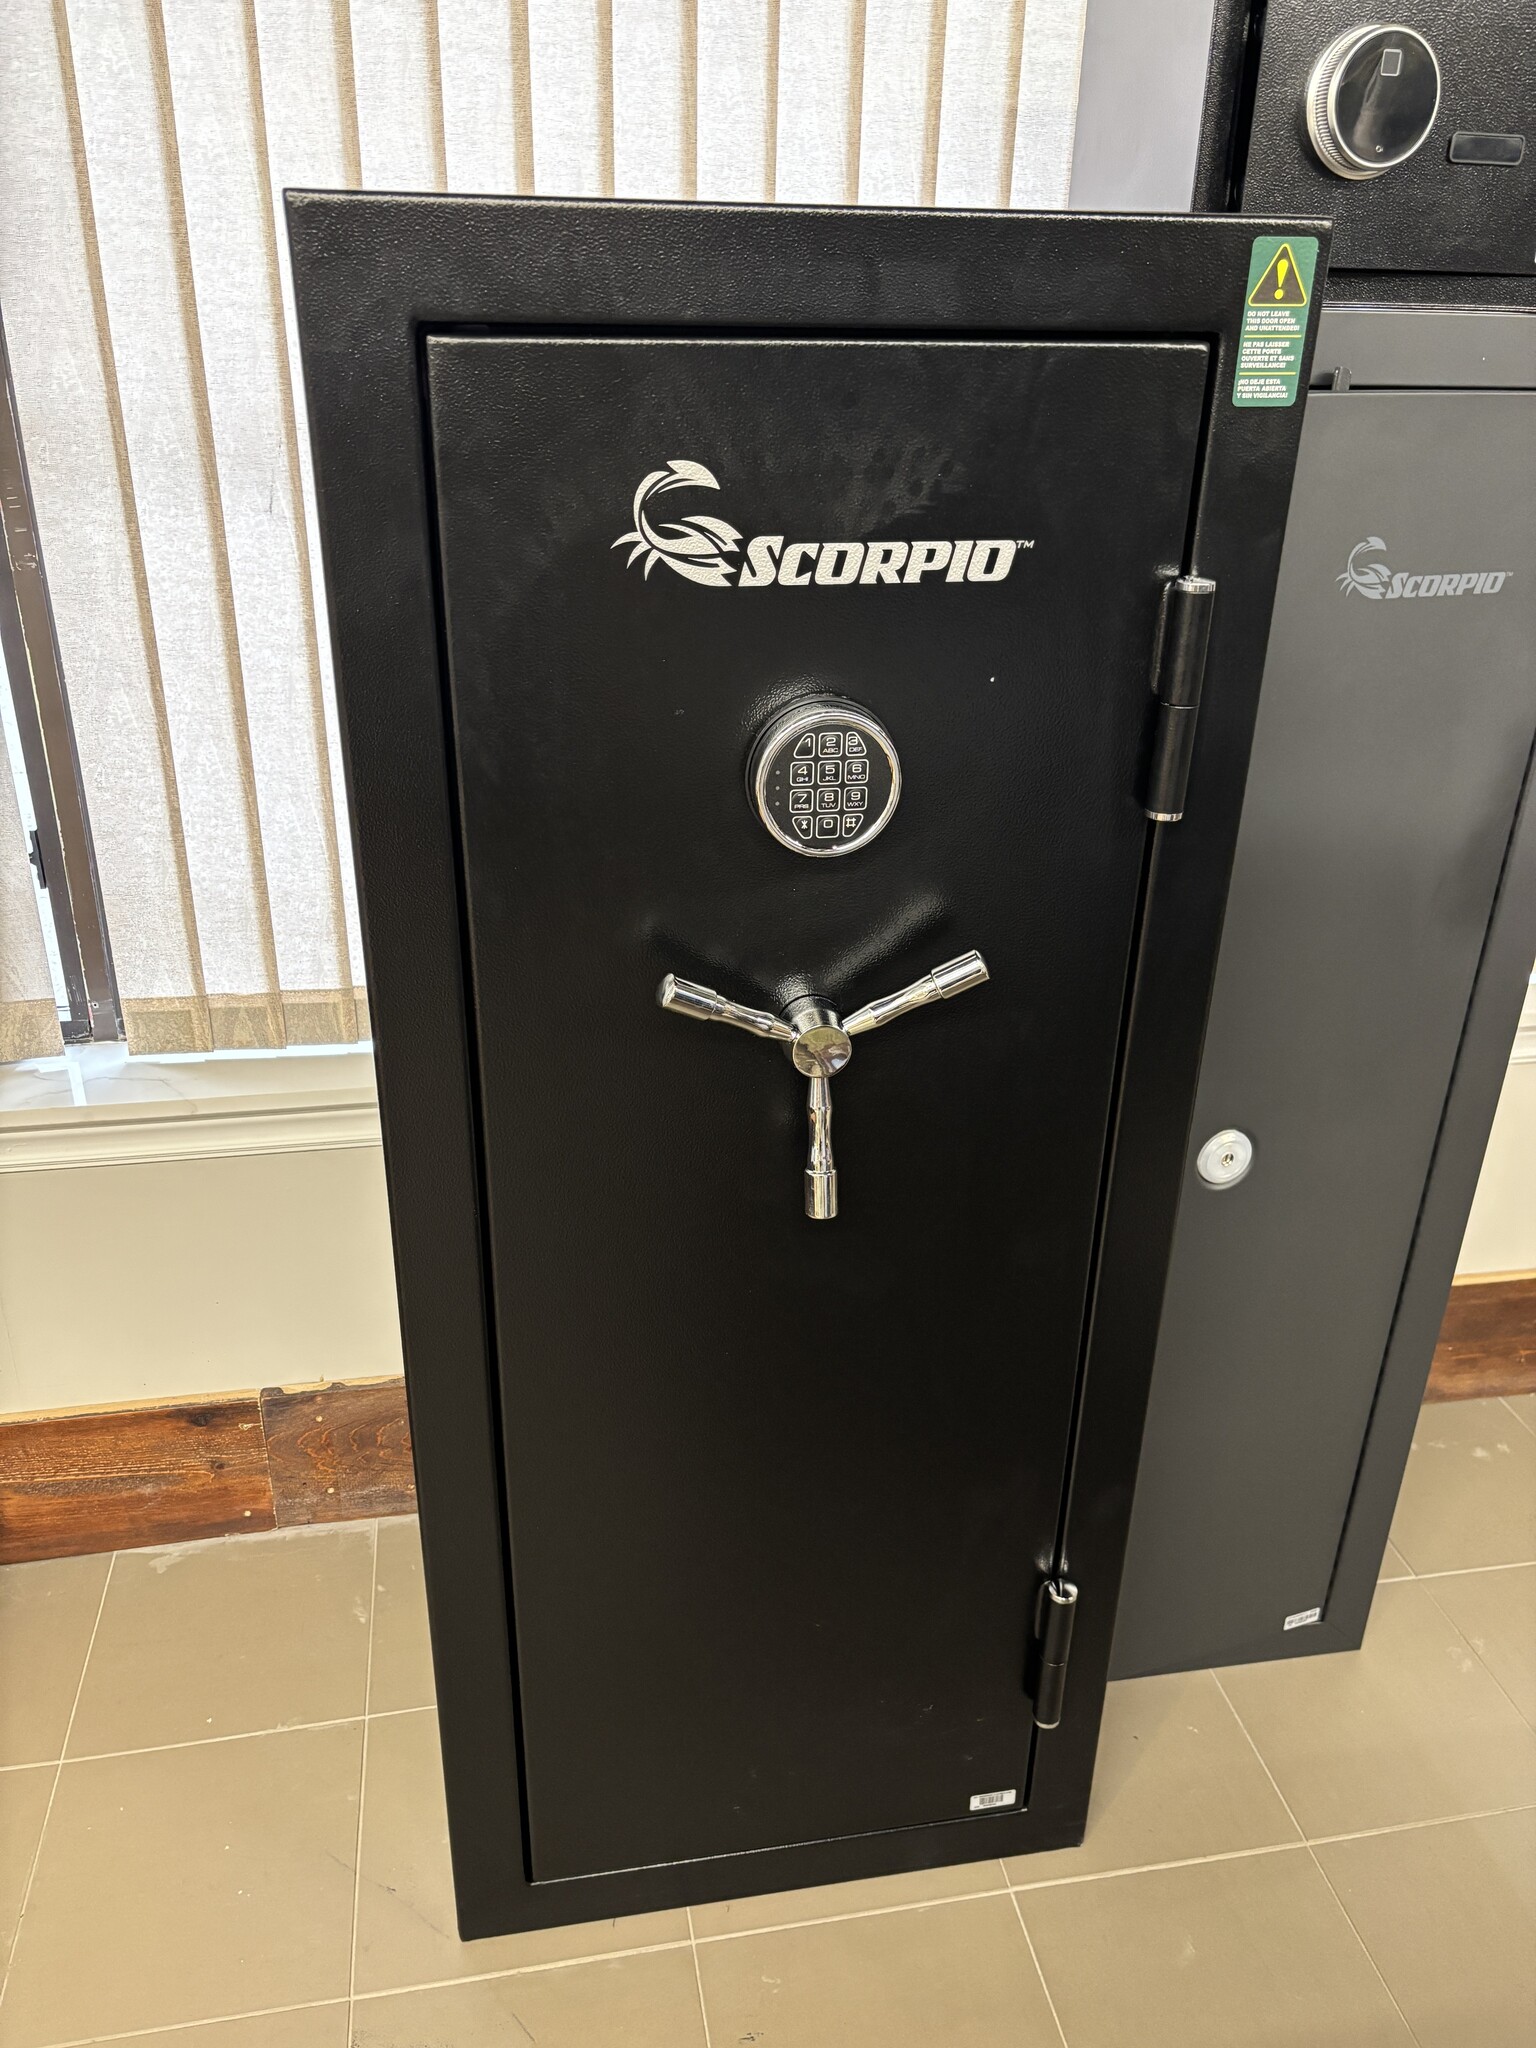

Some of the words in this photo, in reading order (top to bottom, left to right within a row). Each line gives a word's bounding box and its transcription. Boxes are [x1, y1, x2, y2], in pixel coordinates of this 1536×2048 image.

[738, 536, 1016, 588] SCORPIO
[1385, 571, 1506, 599] SCORPIO
[804, 737, 811, 748] 1
[826, 737, 836, 747] 2
[848, 736, 858, 746] 3
[797, 765, 808, 775] 4
[825, 764, 835, 774] 5
[852, 763, 862, 773] 6
[797, 793, 807, 803] 7
[824, 792, 834, 802] 8
[851, 791, 860, 801] 9
[823, 819, 833, 829] 0
[845, 817, 857, 828] #
